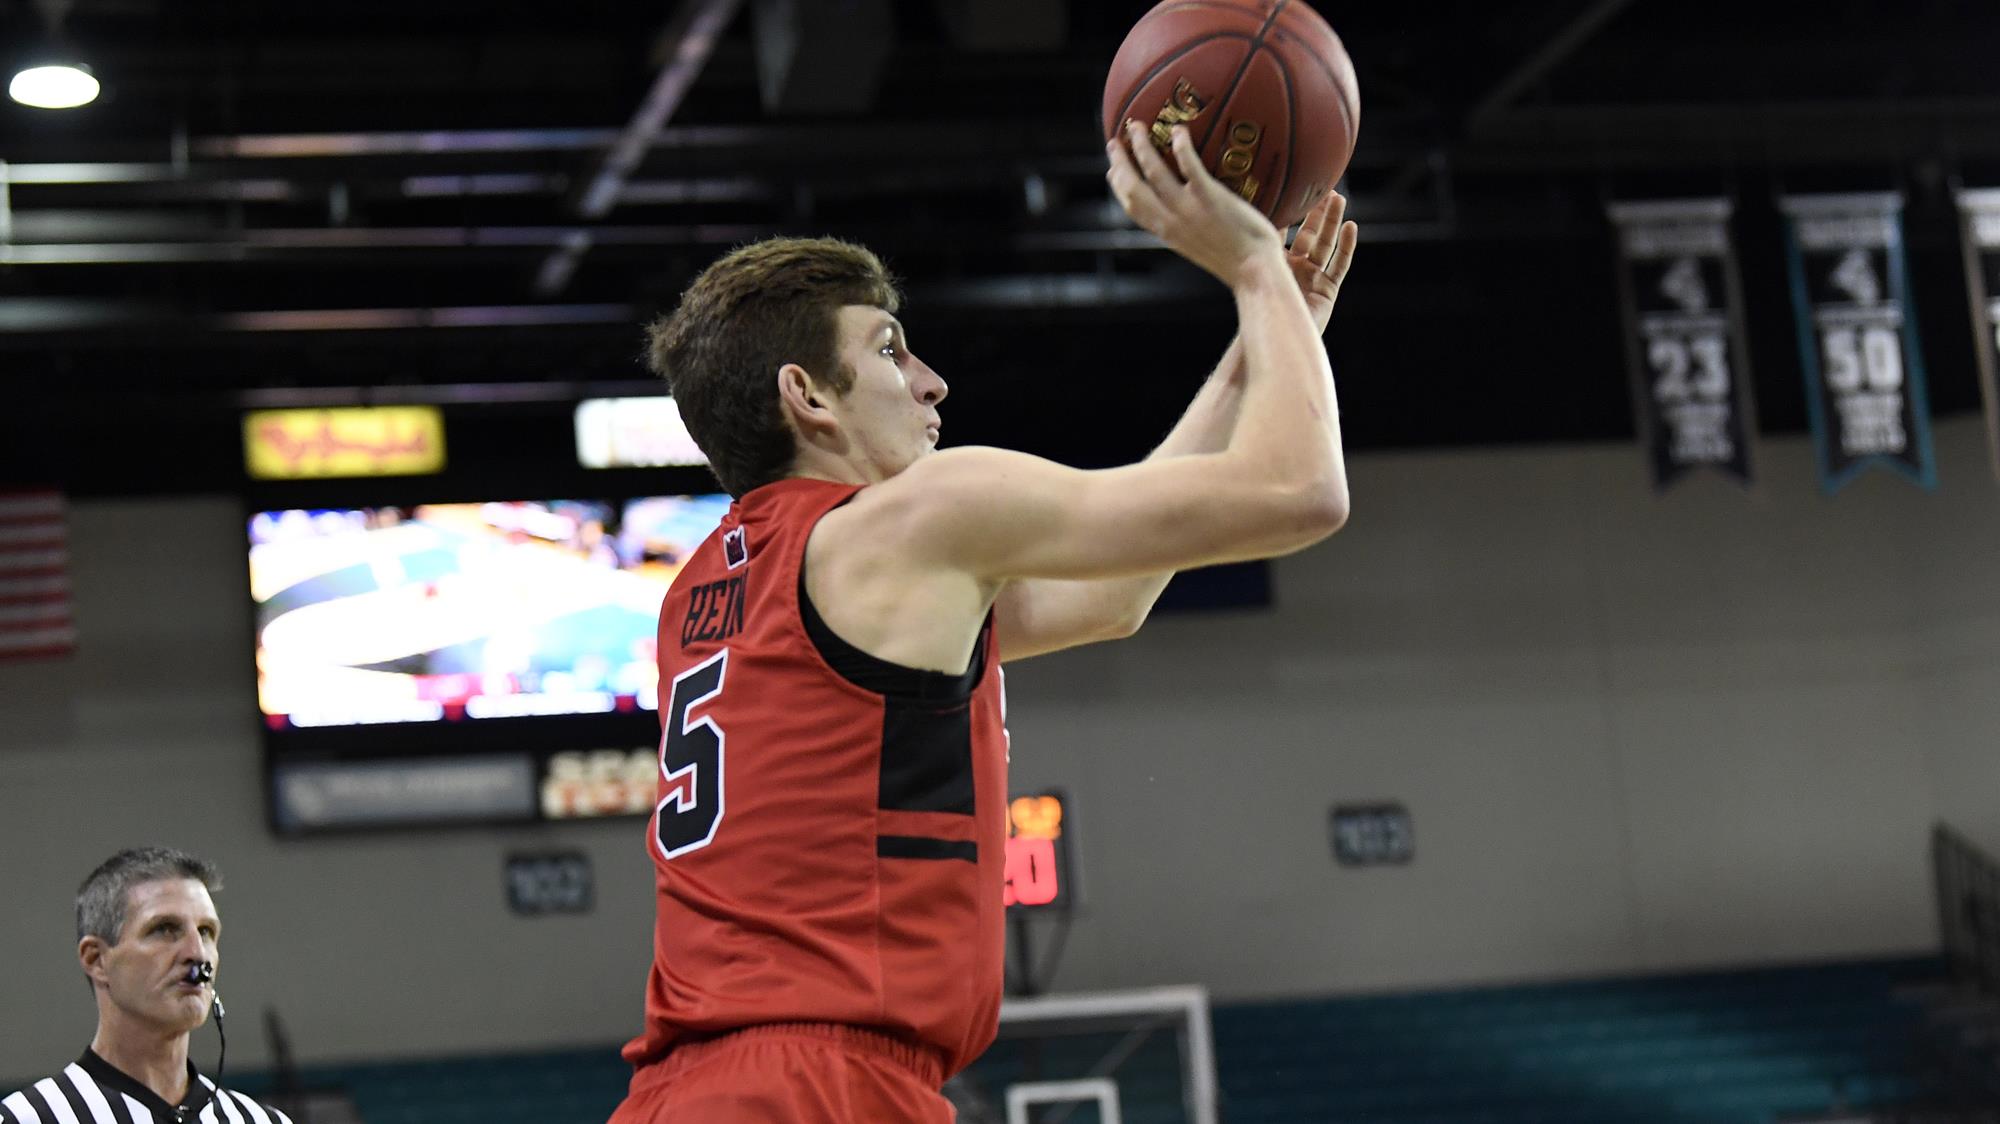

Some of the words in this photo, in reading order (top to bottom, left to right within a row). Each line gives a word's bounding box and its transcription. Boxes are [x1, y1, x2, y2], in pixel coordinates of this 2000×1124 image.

[1651, 336, 1730, 399] 23
[1824, 326, 1904, 389] 50
[681, 570, 748, 648] HEIN
[656, 647, 729, 860] 5
